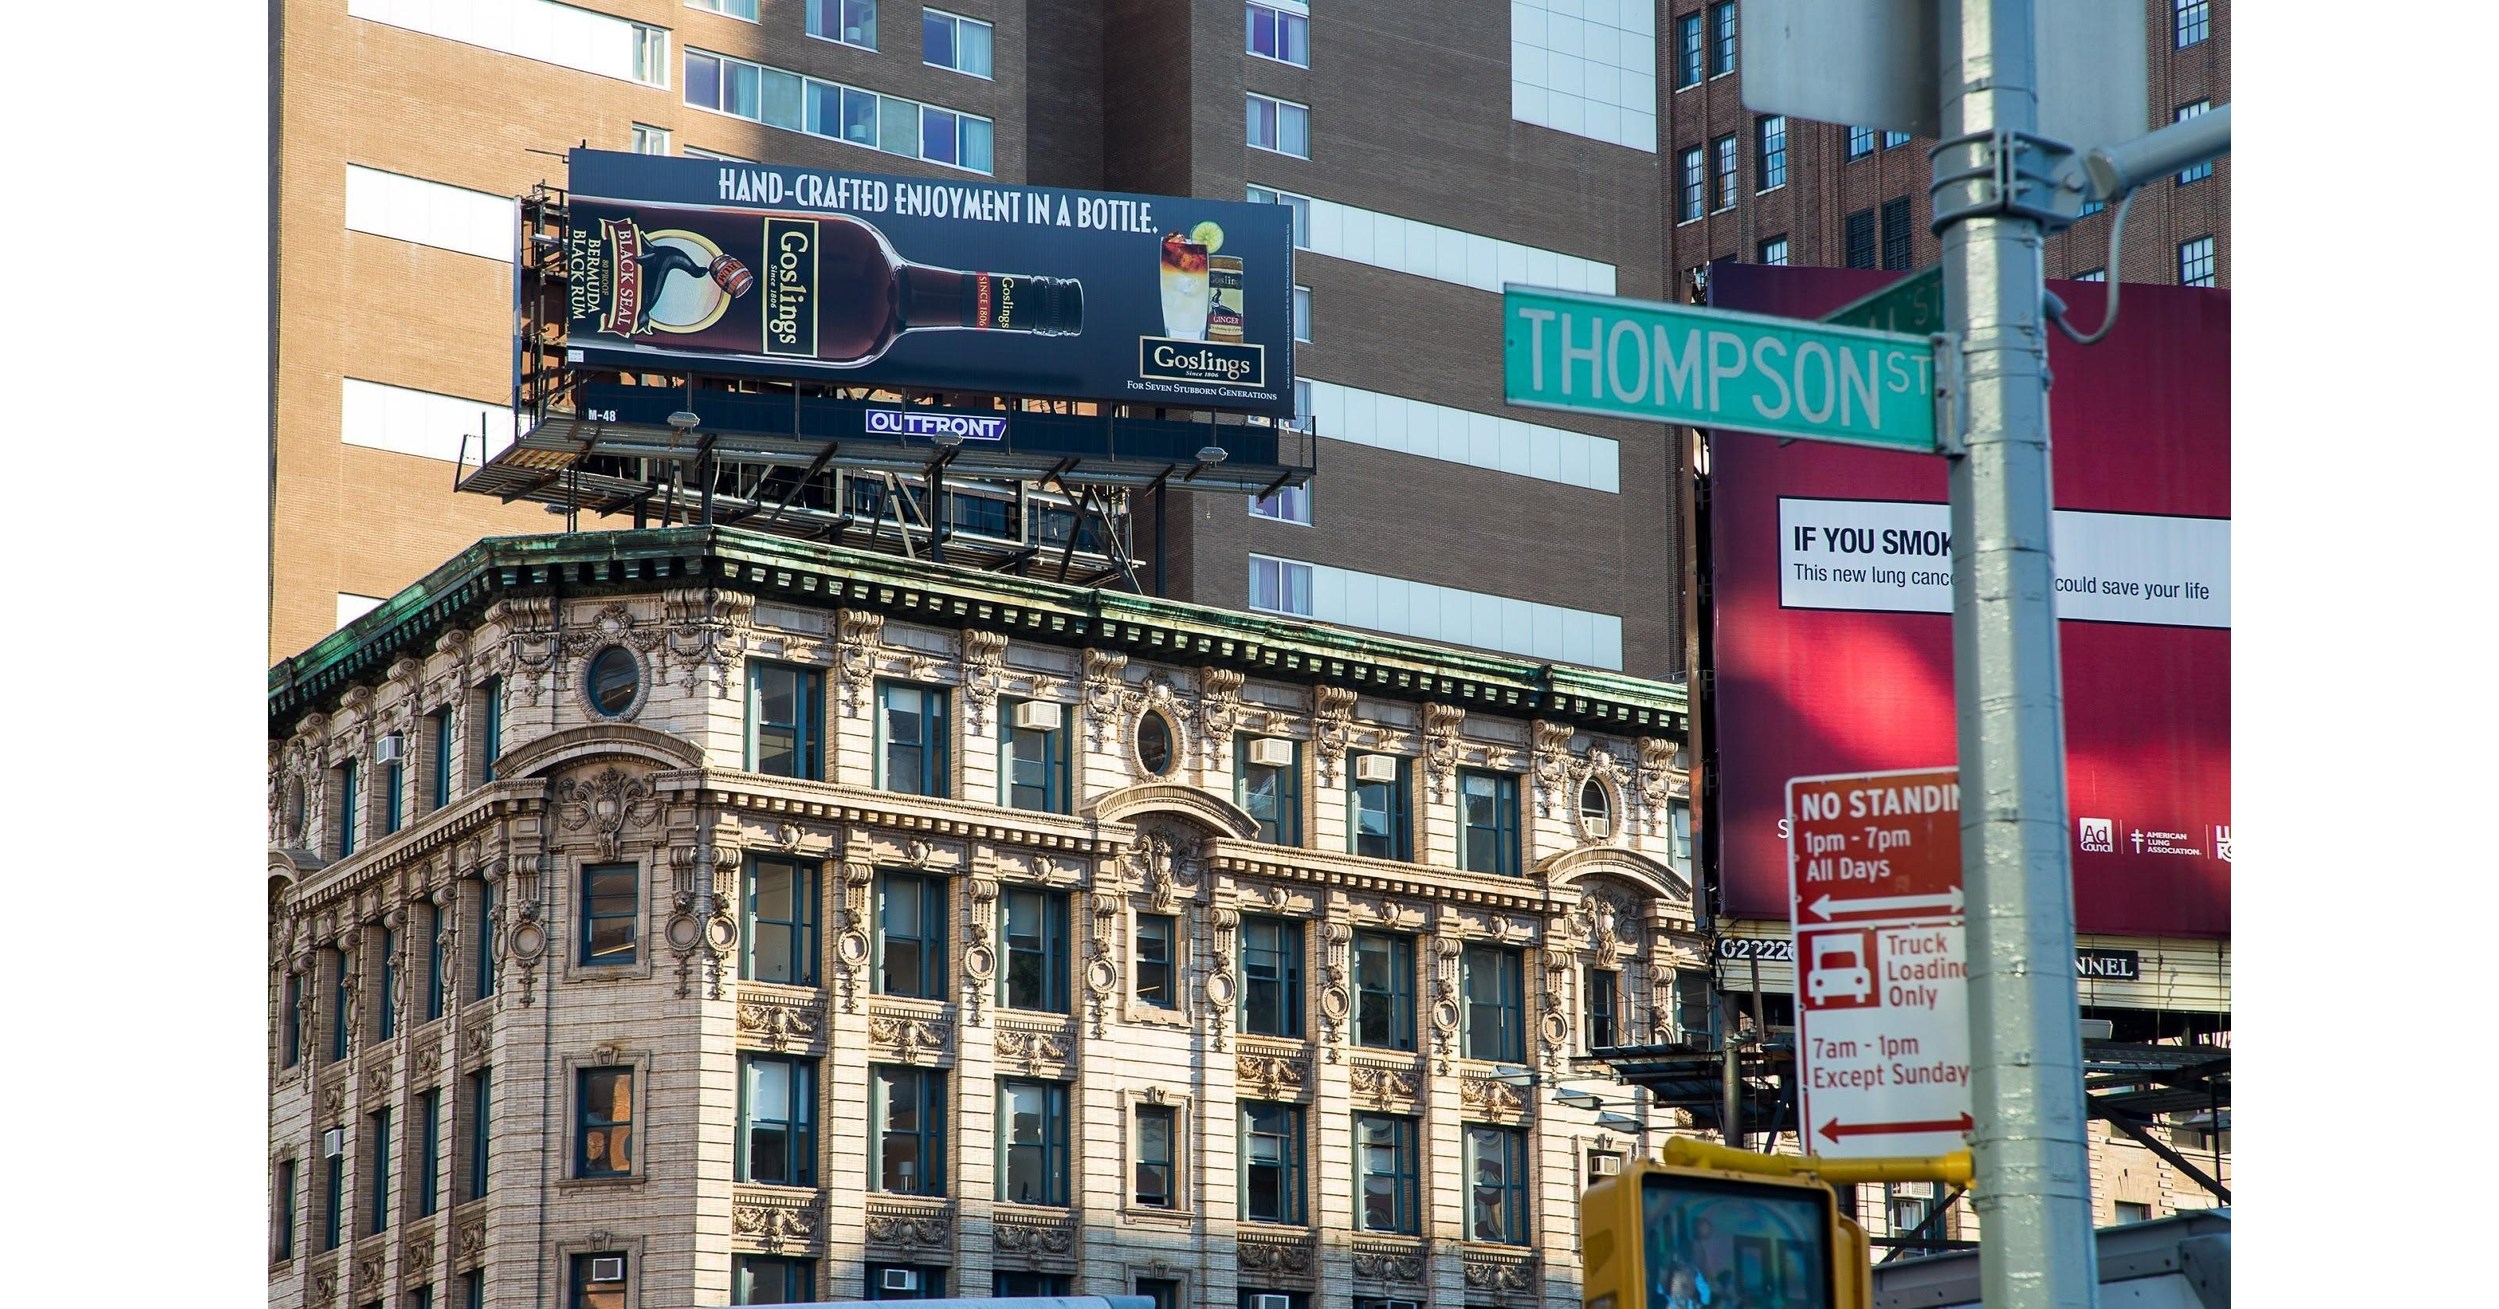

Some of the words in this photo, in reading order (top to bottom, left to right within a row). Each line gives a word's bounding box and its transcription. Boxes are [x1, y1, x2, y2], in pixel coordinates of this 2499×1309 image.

[719, 168, 888, 212] HAND-CRAFTED
[894, 183, 1021, 223] ENJOYMENT
[1027, 192, 1050, 226] IN
[1056, 195, 1071, 227] A
[1077, 197, 1159, 235] BOTTLE.
[571, 230, 586, 282] BLACK
[618, 230, 634, 284] BLACK
[587, 239, 601, 313] BERMUDA
[718, 263, 737, 282] RUM
[770, 264, 778, 287] Since
[770, 231, 808, 344] Goslings
[770, 289, 778, 309] 1806
[979, 276, 988, 305] SINCE
[571, 286, 586, 320] RUM
[617, 289, 634, 325] SEAL
[979, 307, 988, 326] 1806
[998, 277, 1014, 328] Goslings
[1213, 316, 1239, 324] GINGER
[1154, 345, 1250, 380] Goslings
[1518, 307, 1880, 430] THOMPSON
[1887, 349, 1932, 396] ST
[588, 409, 616, 422] M-48
[871, 412, 1001, 437] OUTFRONT
[1794, 526, 1816, 551] IF
[1823, 527, 1874, 554] YOU
[1793, 563, 1827, 582] This
[1833, 568, 1866, 583] new
[1872, 566, 1906, 588] lung
[2055, 576, 2097, 593] could
[2102, 580, 2139, 596] save
[2145, 583, 2180, 600] your
[2185, 582, 2209, 600] life
[1801, 791, 1841, 822] NO
[1804, 831, 1845, 857] 1pm
[1864, 826, 1911, 853] 7pm
[2080, 841, 2113, 852] Council
[2083, 825, 2107, 843] Ad
[2146, 831, 2187, 840] AMERICAN
[2148, 839, 2170, 847] LUNG
[1806, 858, 1833, 882] All
[1840, 857, 1890, 884] Days
[1887, 932, 1948, 956] Truck
[1889, 985, 1938, 1011] Only
[1812, 1037, 1858, 1059] 7am
[1878, 1034, 1920, 1060] 1pm
[1813, 1064, 1885, 1091] Except
[1892, 1060, 1970, 1088] Sunday
